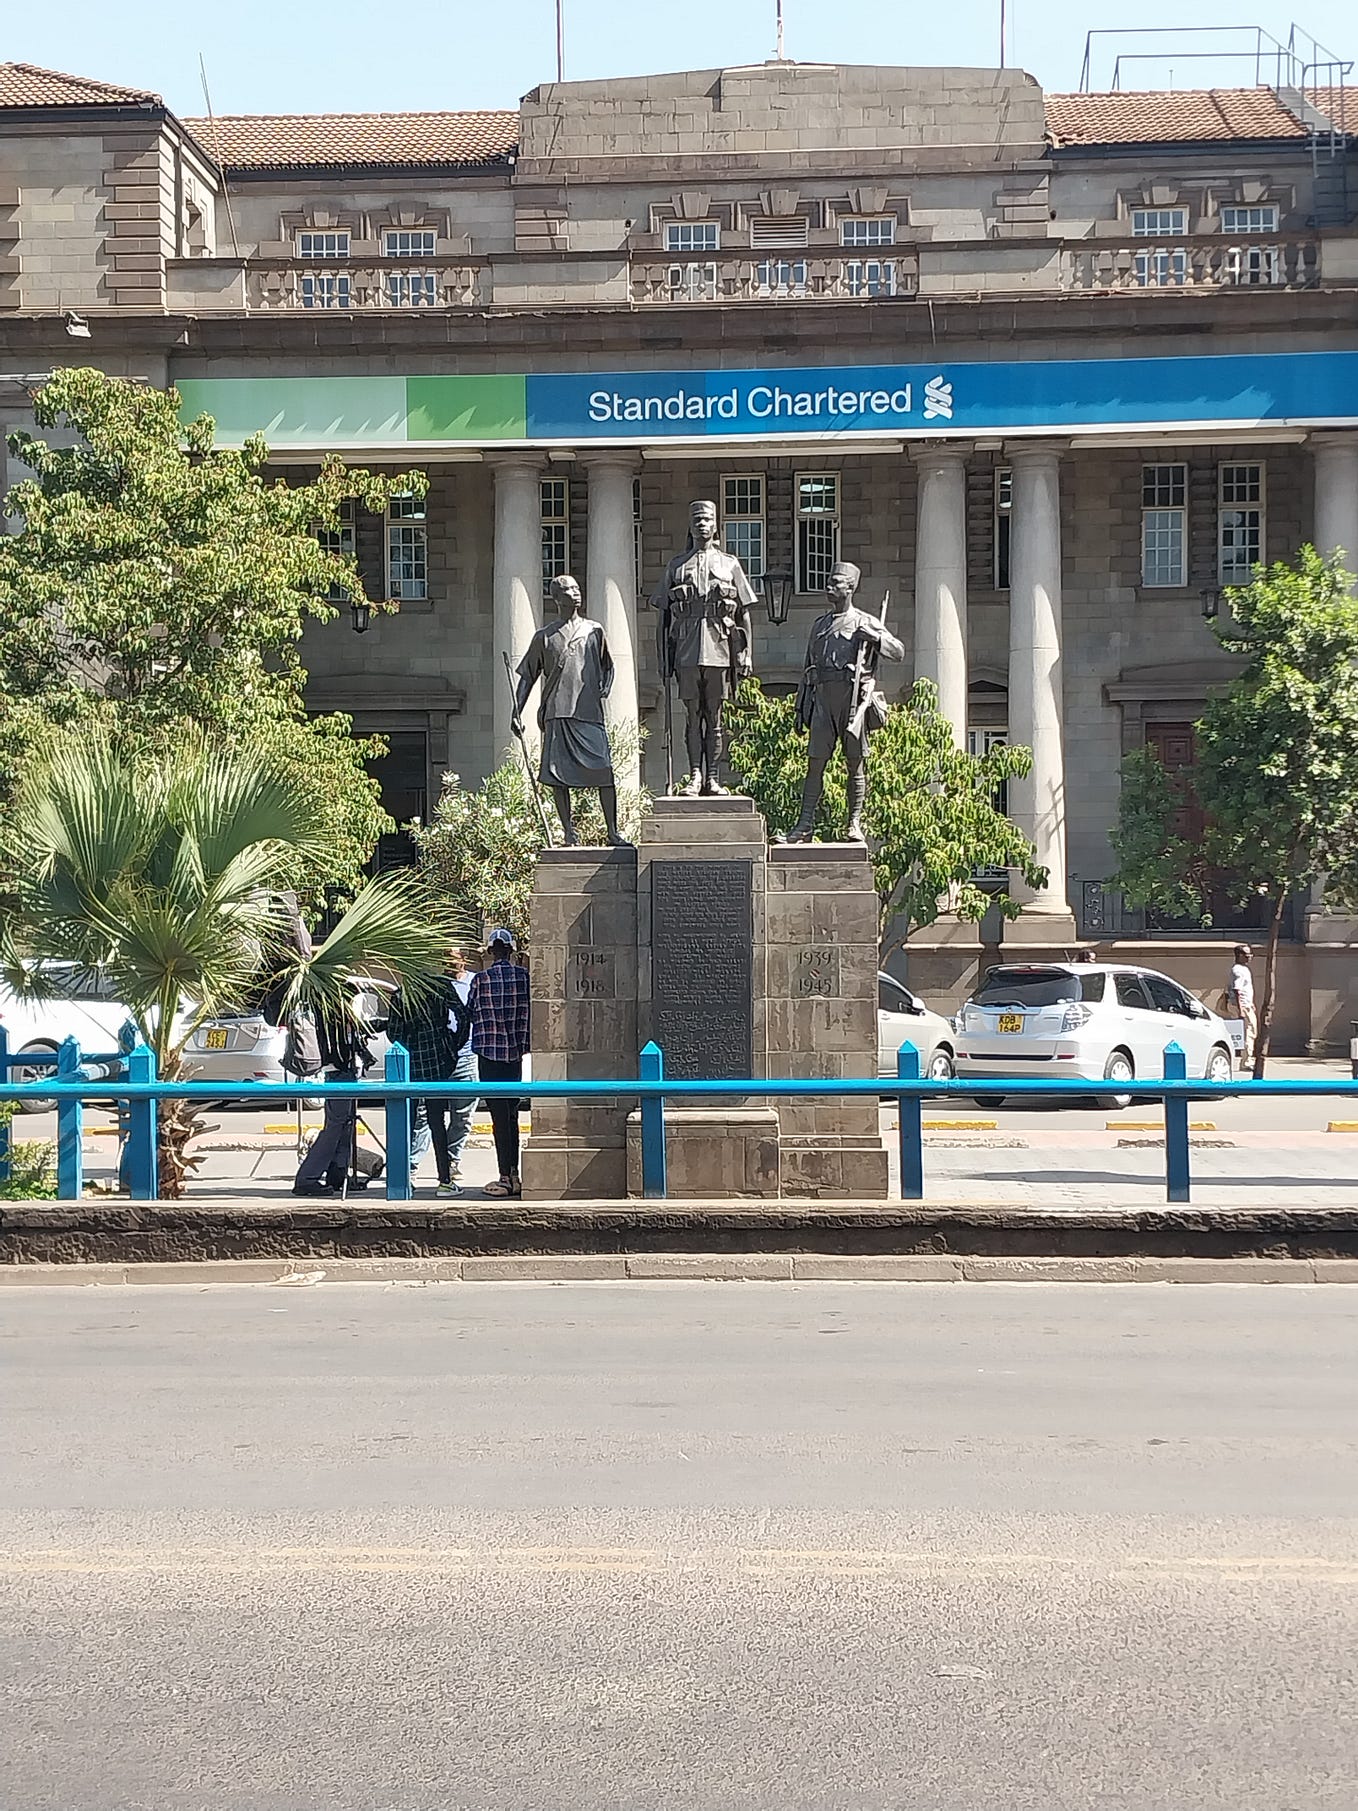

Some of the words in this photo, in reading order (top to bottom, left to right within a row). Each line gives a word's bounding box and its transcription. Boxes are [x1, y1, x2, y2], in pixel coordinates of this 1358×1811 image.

[588, 388, 738, 422] Standard
[747, 383, 912, 418] Chartered
[576, 952, 607, 965] 1914
[799, 951, 831, 966] 1939
[576, 980, 605, 993] 1918
[799, 979, 832, 994] 1945
[999, 1015, 1016, 1024] KDB
[1000, 1024, 1021, 1033] 164P
